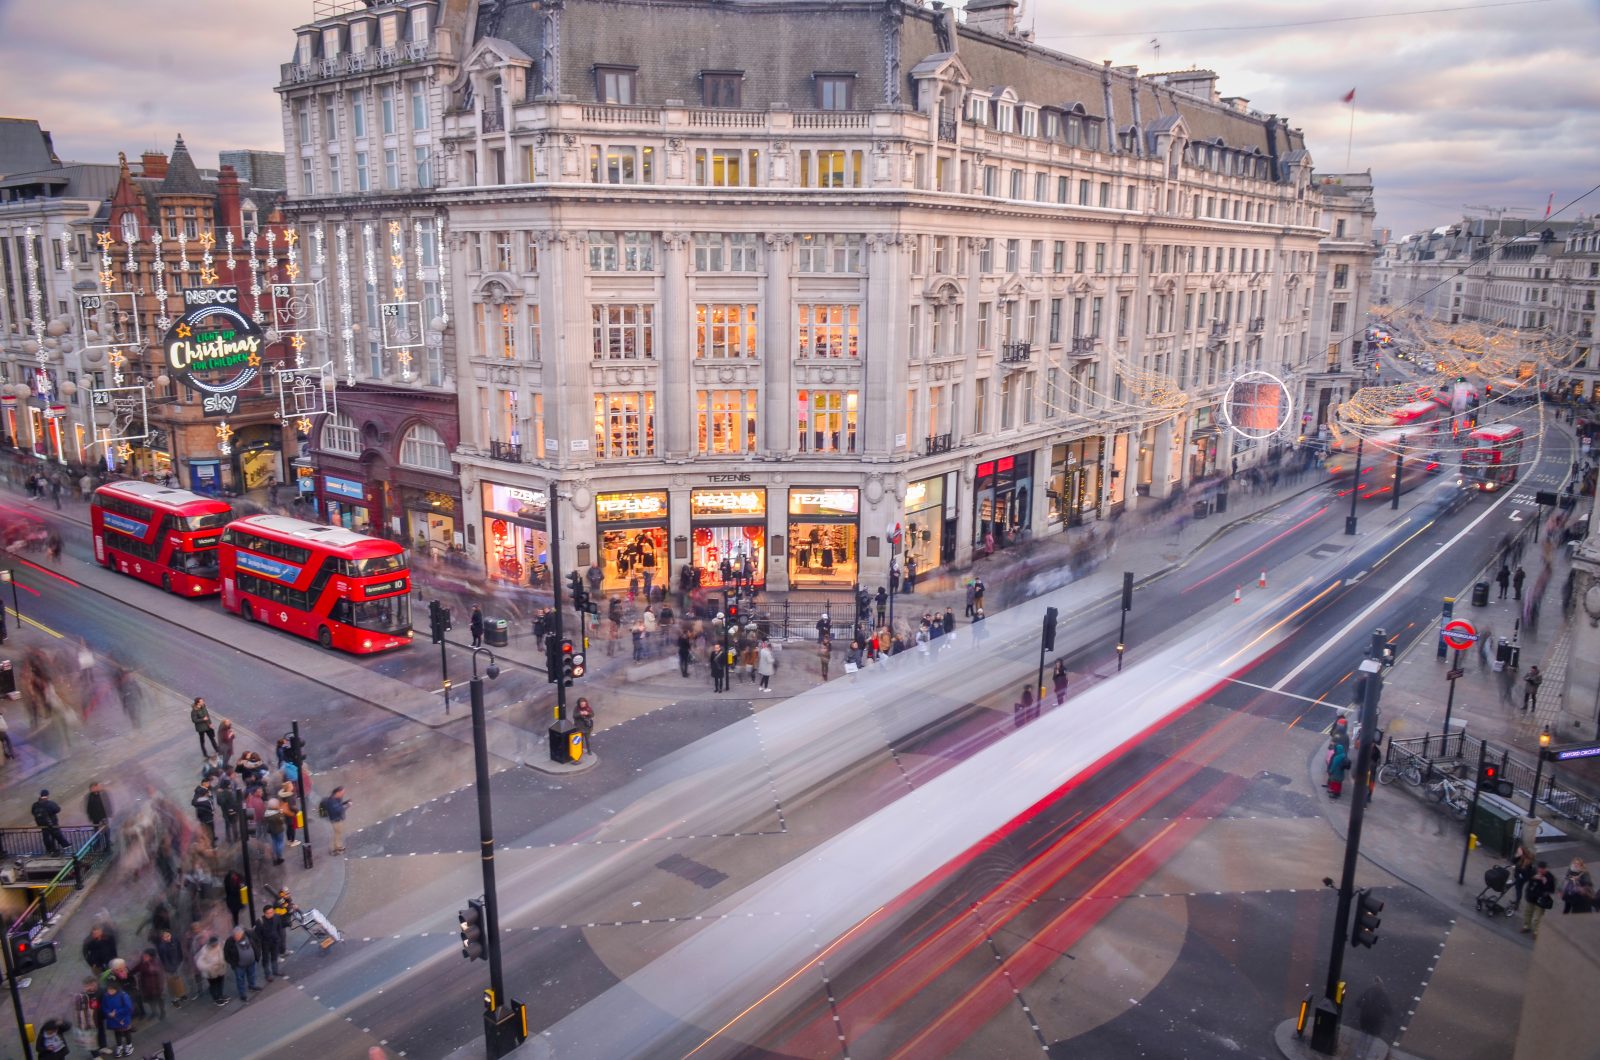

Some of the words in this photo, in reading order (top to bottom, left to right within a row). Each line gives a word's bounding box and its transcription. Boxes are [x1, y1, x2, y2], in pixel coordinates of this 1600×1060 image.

[185, 289, 237, 304] NSPCC
[223, 330, 235, 340] UP
[170, 336, 260, 368] Christmas
[204, 393, 237, 413] sky
[706, 473, 751, 483] TEZENIS
[1441, 630, 1478, 640] UNDERGROUND
